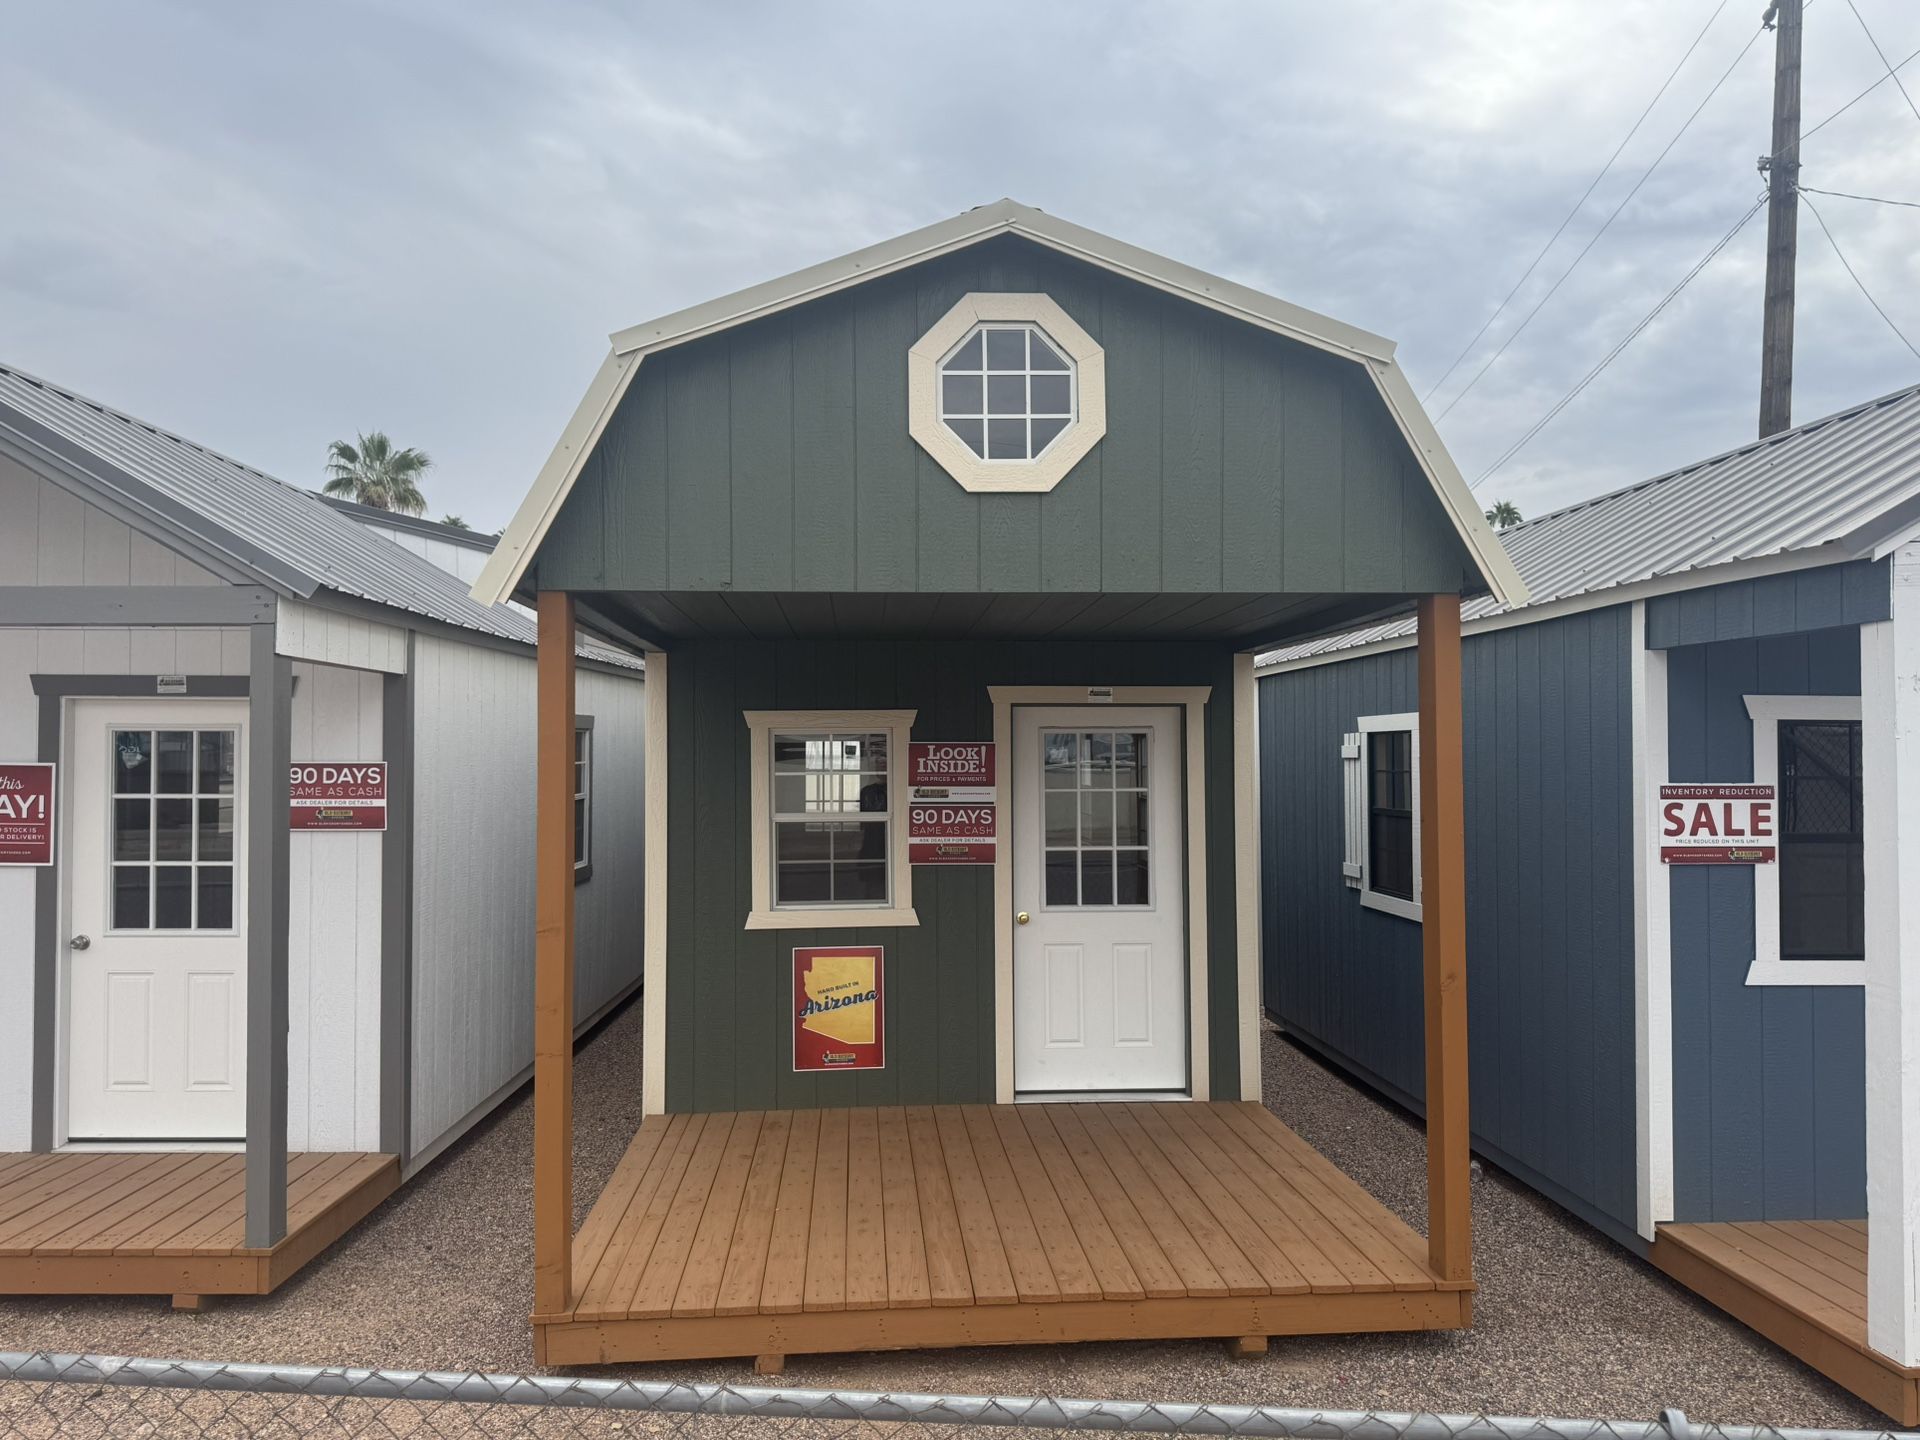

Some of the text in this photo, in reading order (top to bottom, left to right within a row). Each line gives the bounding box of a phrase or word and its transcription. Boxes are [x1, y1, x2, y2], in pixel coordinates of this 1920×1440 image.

[917, 746, 986, 773] INSIDE!
[928, 745, 980, 759] LOOK
[290, 767, 381, 784] 90 DAYS
[290, 787, 382, 796] SAME AS CASH
[912, 809, 992, 824] 90 DAYS
[1663, 802, 1772, 837] SALE
[912, 826, 993, 835] SAME AS CASH
[817, 986, 835, 995] HAND
[835, 982, 852, 991] BUILT
[799, 990, 879, 1017] Arizona
